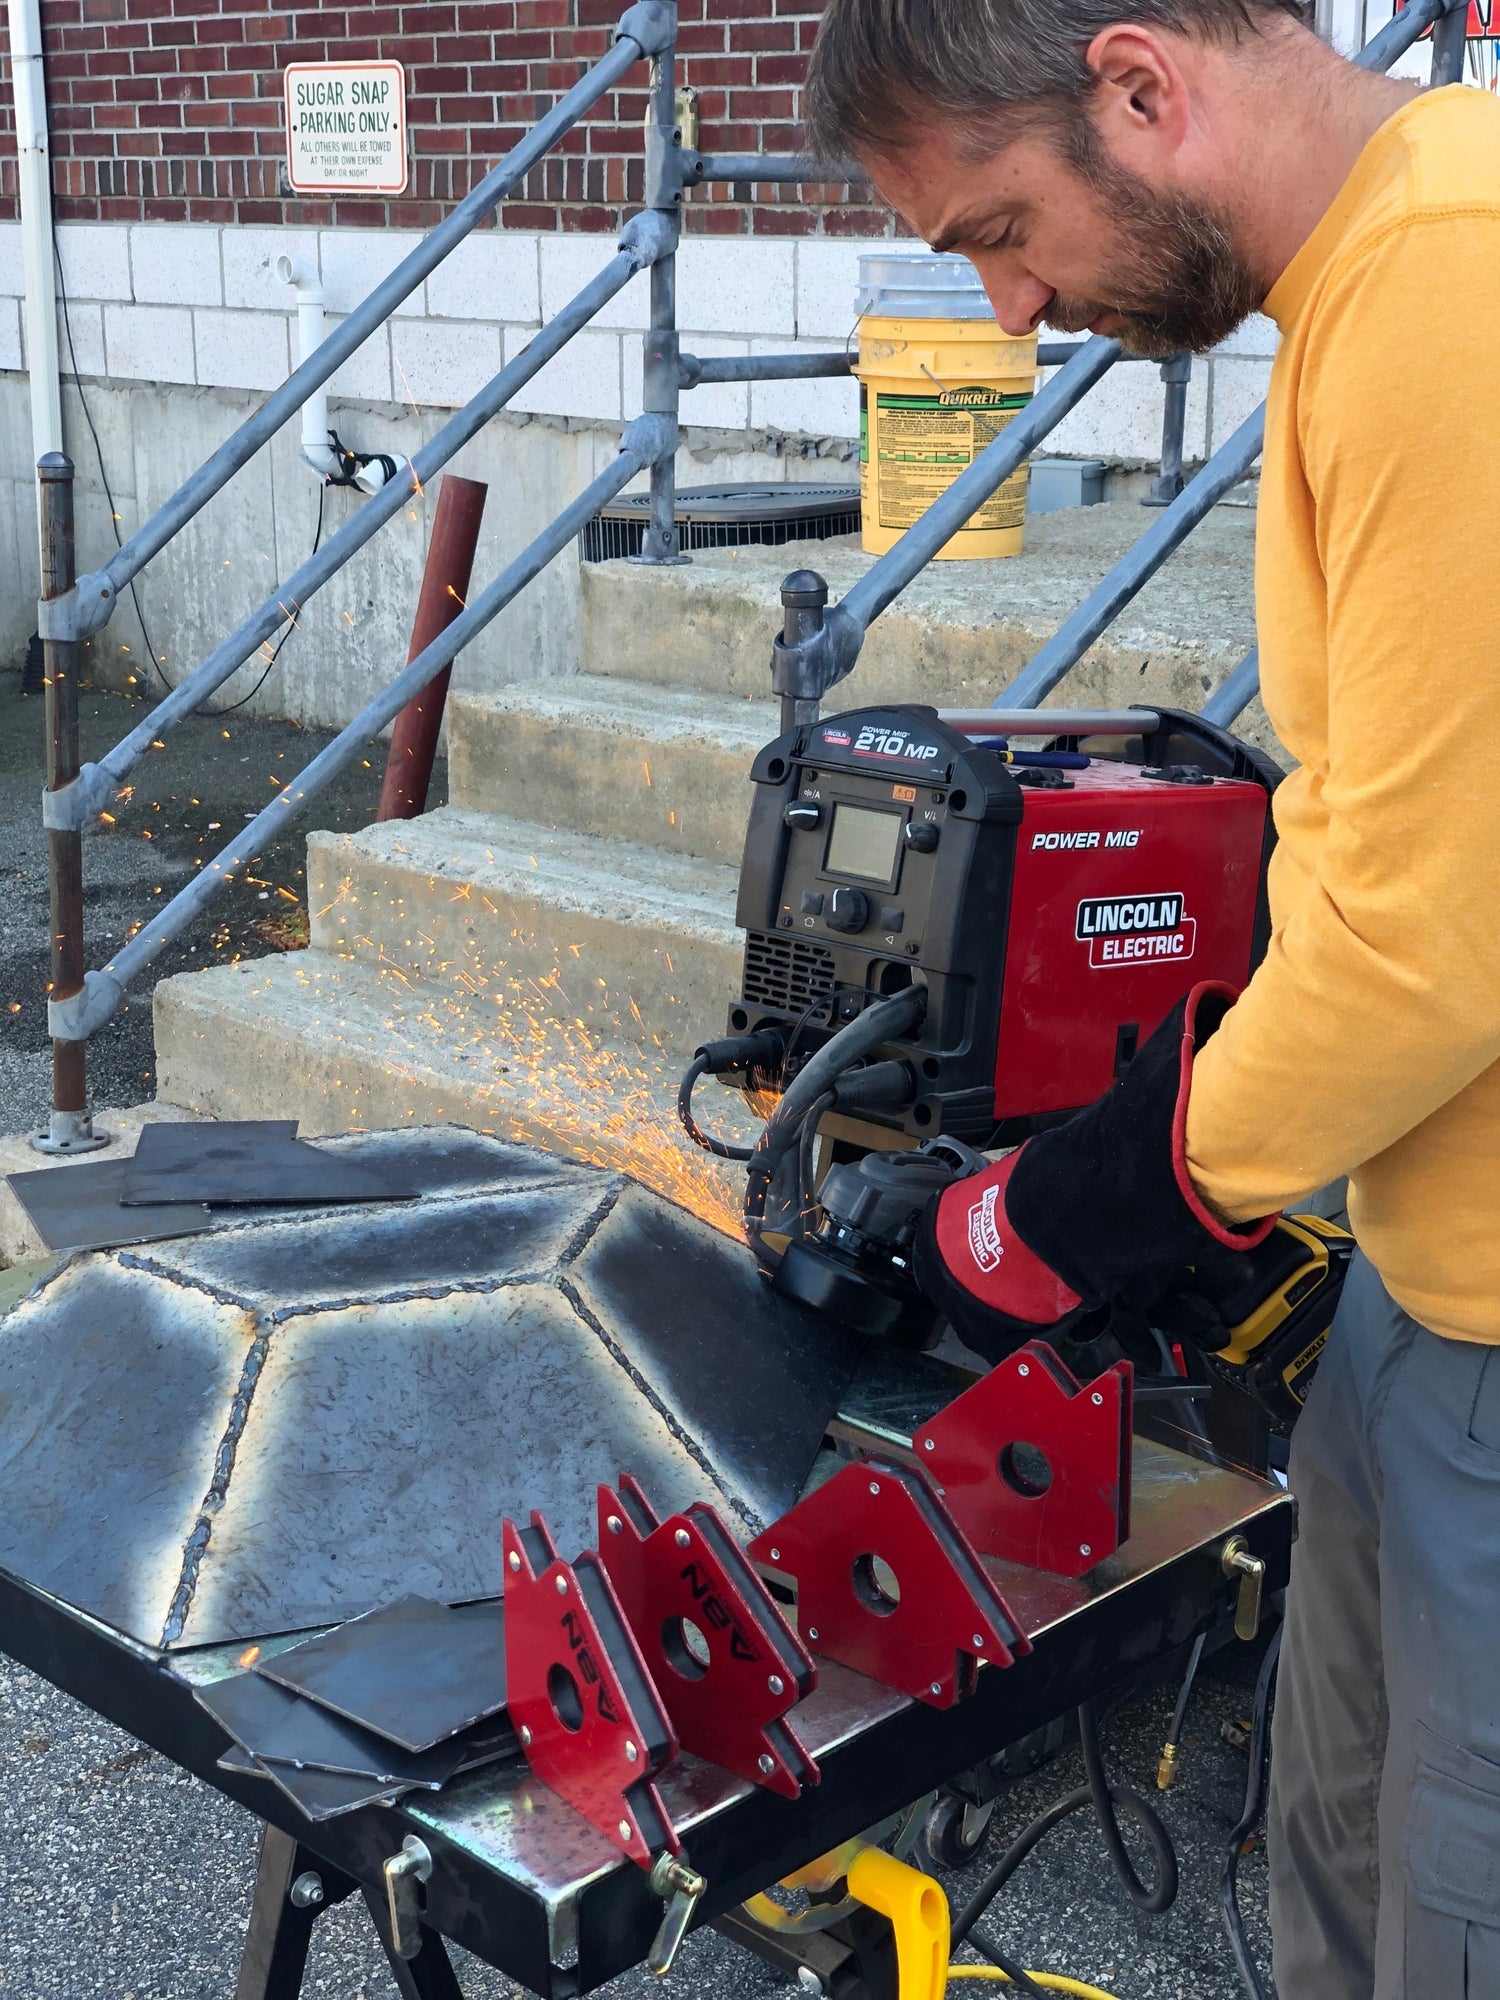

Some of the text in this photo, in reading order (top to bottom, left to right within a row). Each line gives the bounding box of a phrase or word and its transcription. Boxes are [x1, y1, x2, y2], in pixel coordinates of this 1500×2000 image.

[297, 80, 390, 106] SUGAR SNAP
[300, 111, 390, 134] PARKING ONLY
[300, 140, 392, 153] ALL OTHERS WILL BE TOWED
[310, 156, 383, 166] AT THEIR OWN EXPENSE
[324, 168, 368, 178] DAY OR NIGHT
[939, 393, 1003, 406] QUIKRETE
[861, 725, 891, 735] POWER
[854, 732, 939, 760] 210 MP
[1031, 830, 1140, 850] POWER MIG
[1082, 900, 1178, 934] LINCOLN
[1102, 934, 1185, 960] ELECTRIC
[983, 1189, 997, 1246] LINCOLN
[972, 1210, 990, 1263] ELECTRIC
[680, 1562, 760, 1663] ABN
[560, 1610, 621, 1725] ABN
